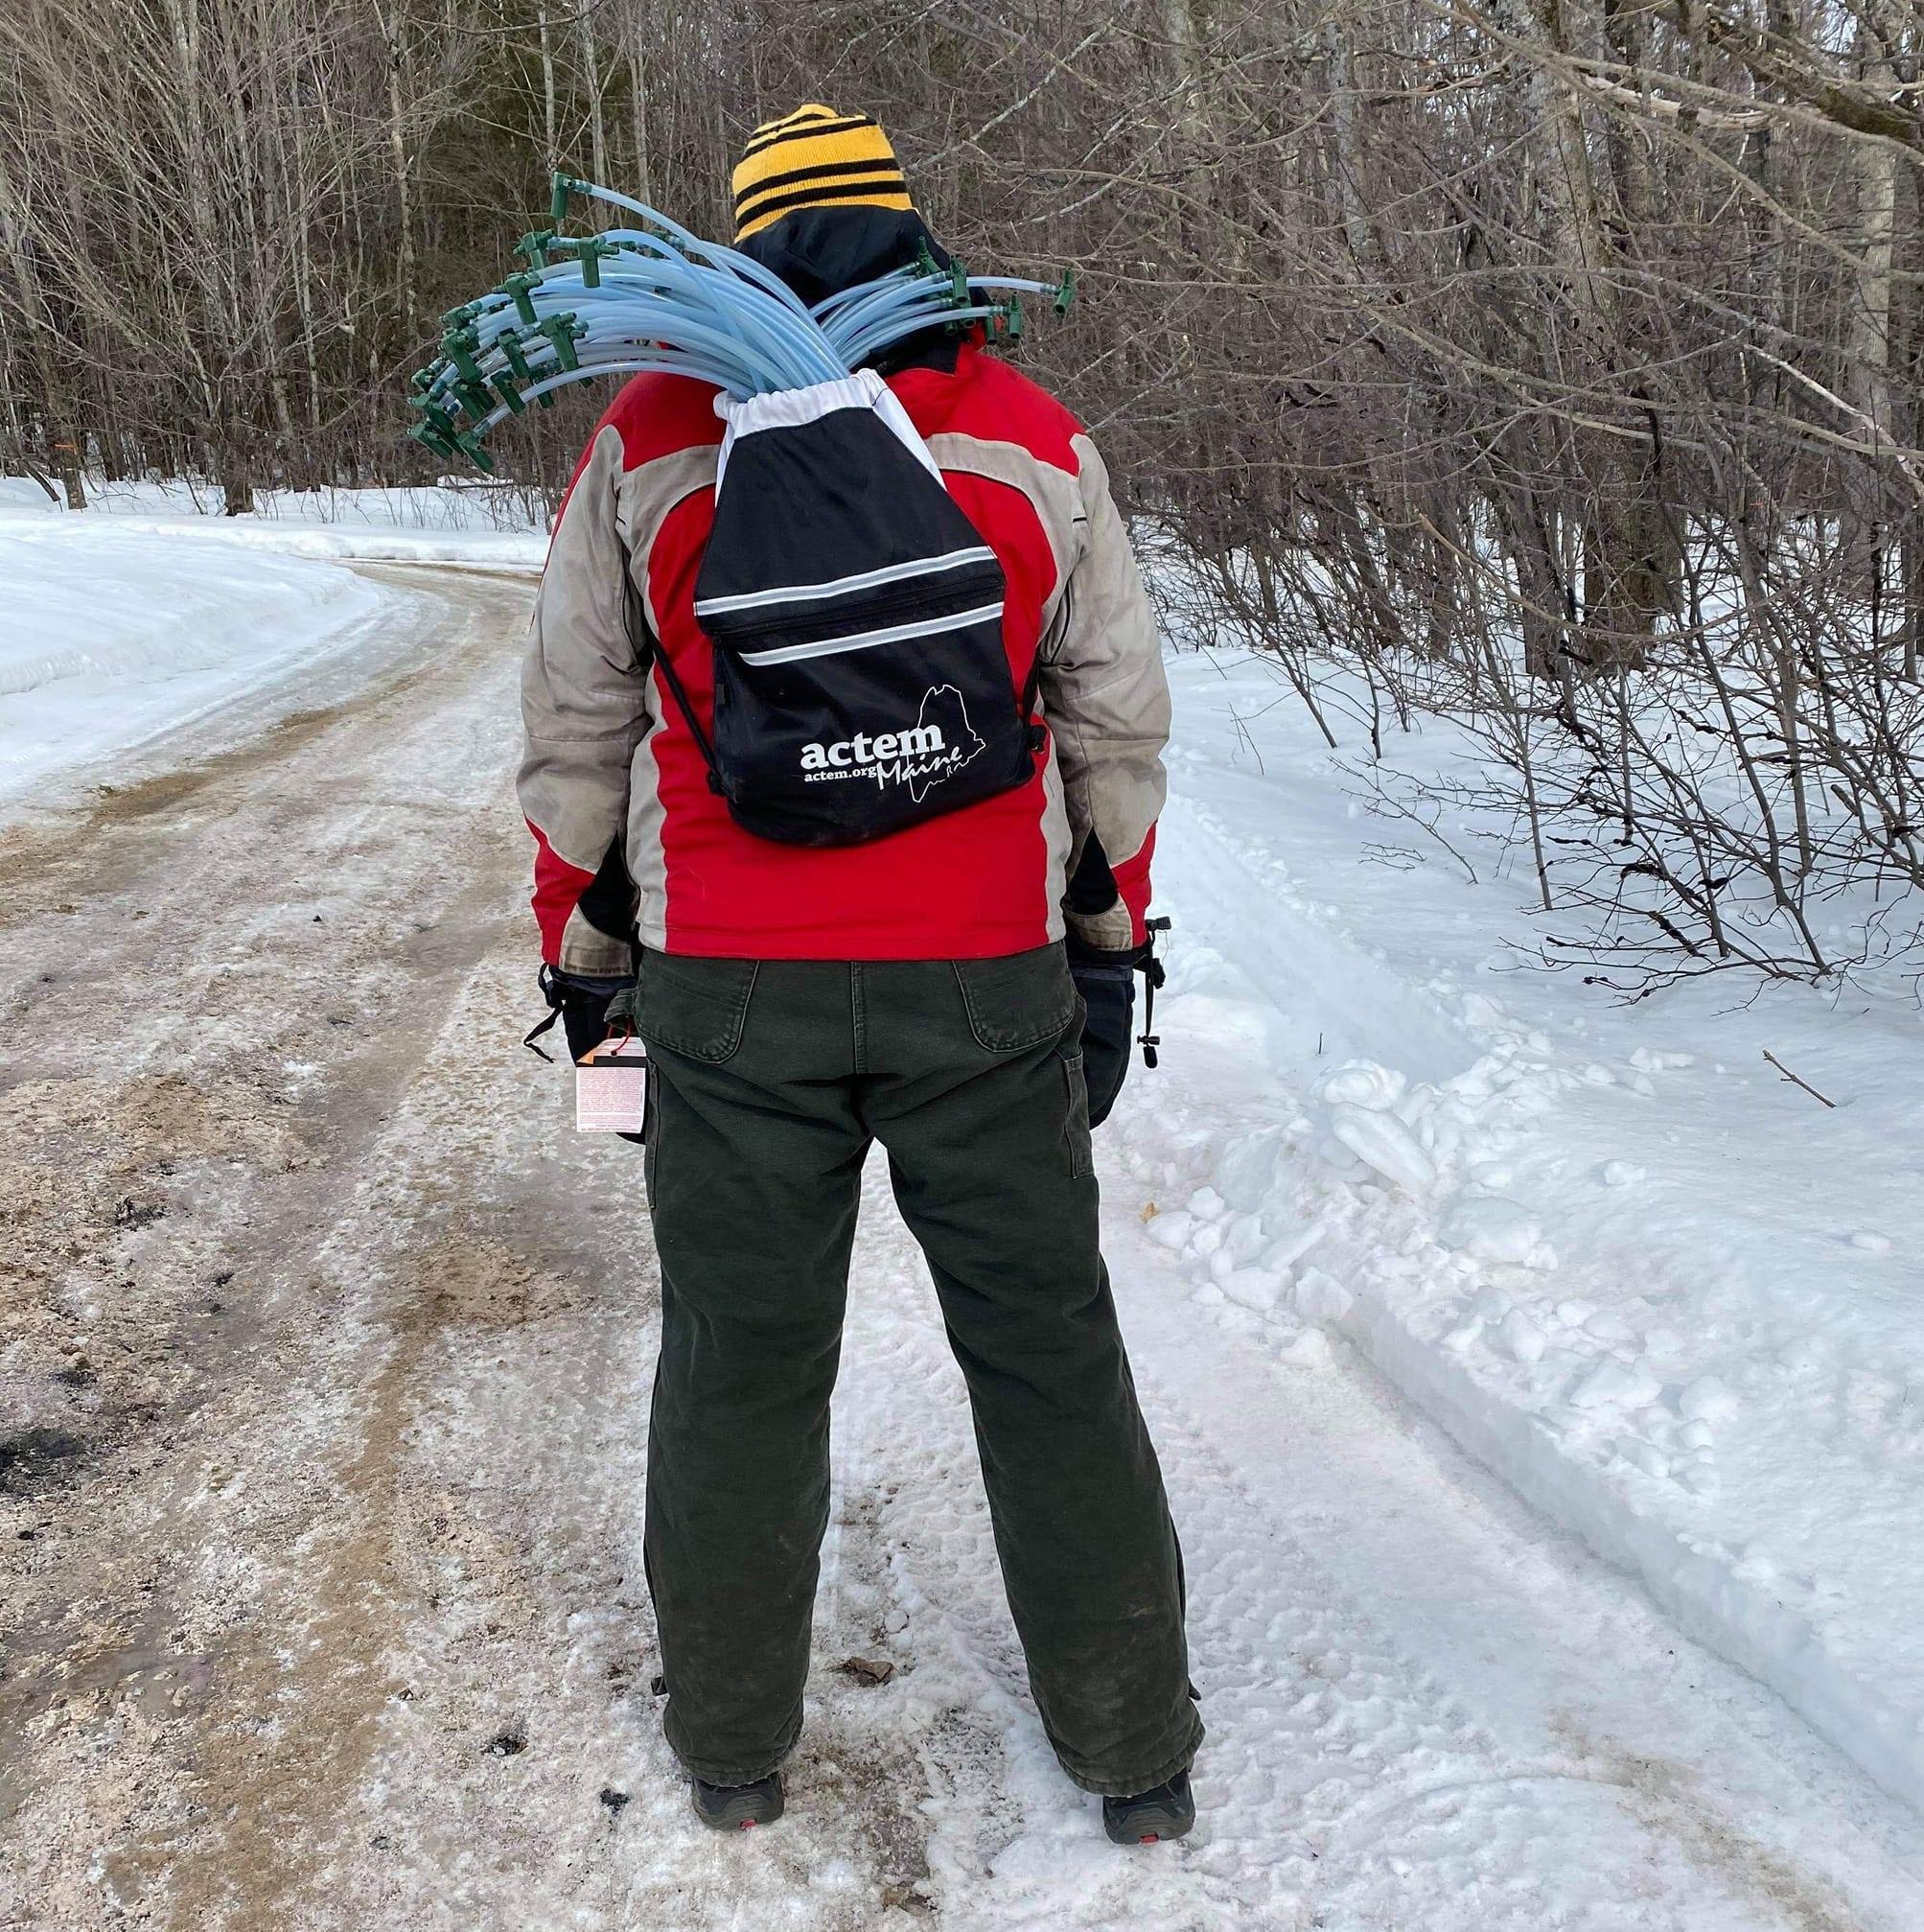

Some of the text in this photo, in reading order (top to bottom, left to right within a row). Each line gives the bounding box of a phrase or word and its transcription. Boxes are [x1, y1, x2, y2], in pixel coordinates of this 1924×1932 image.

[800, 724, 945, 770] actem
[803, 746, 962, 790] actem.org Maine
